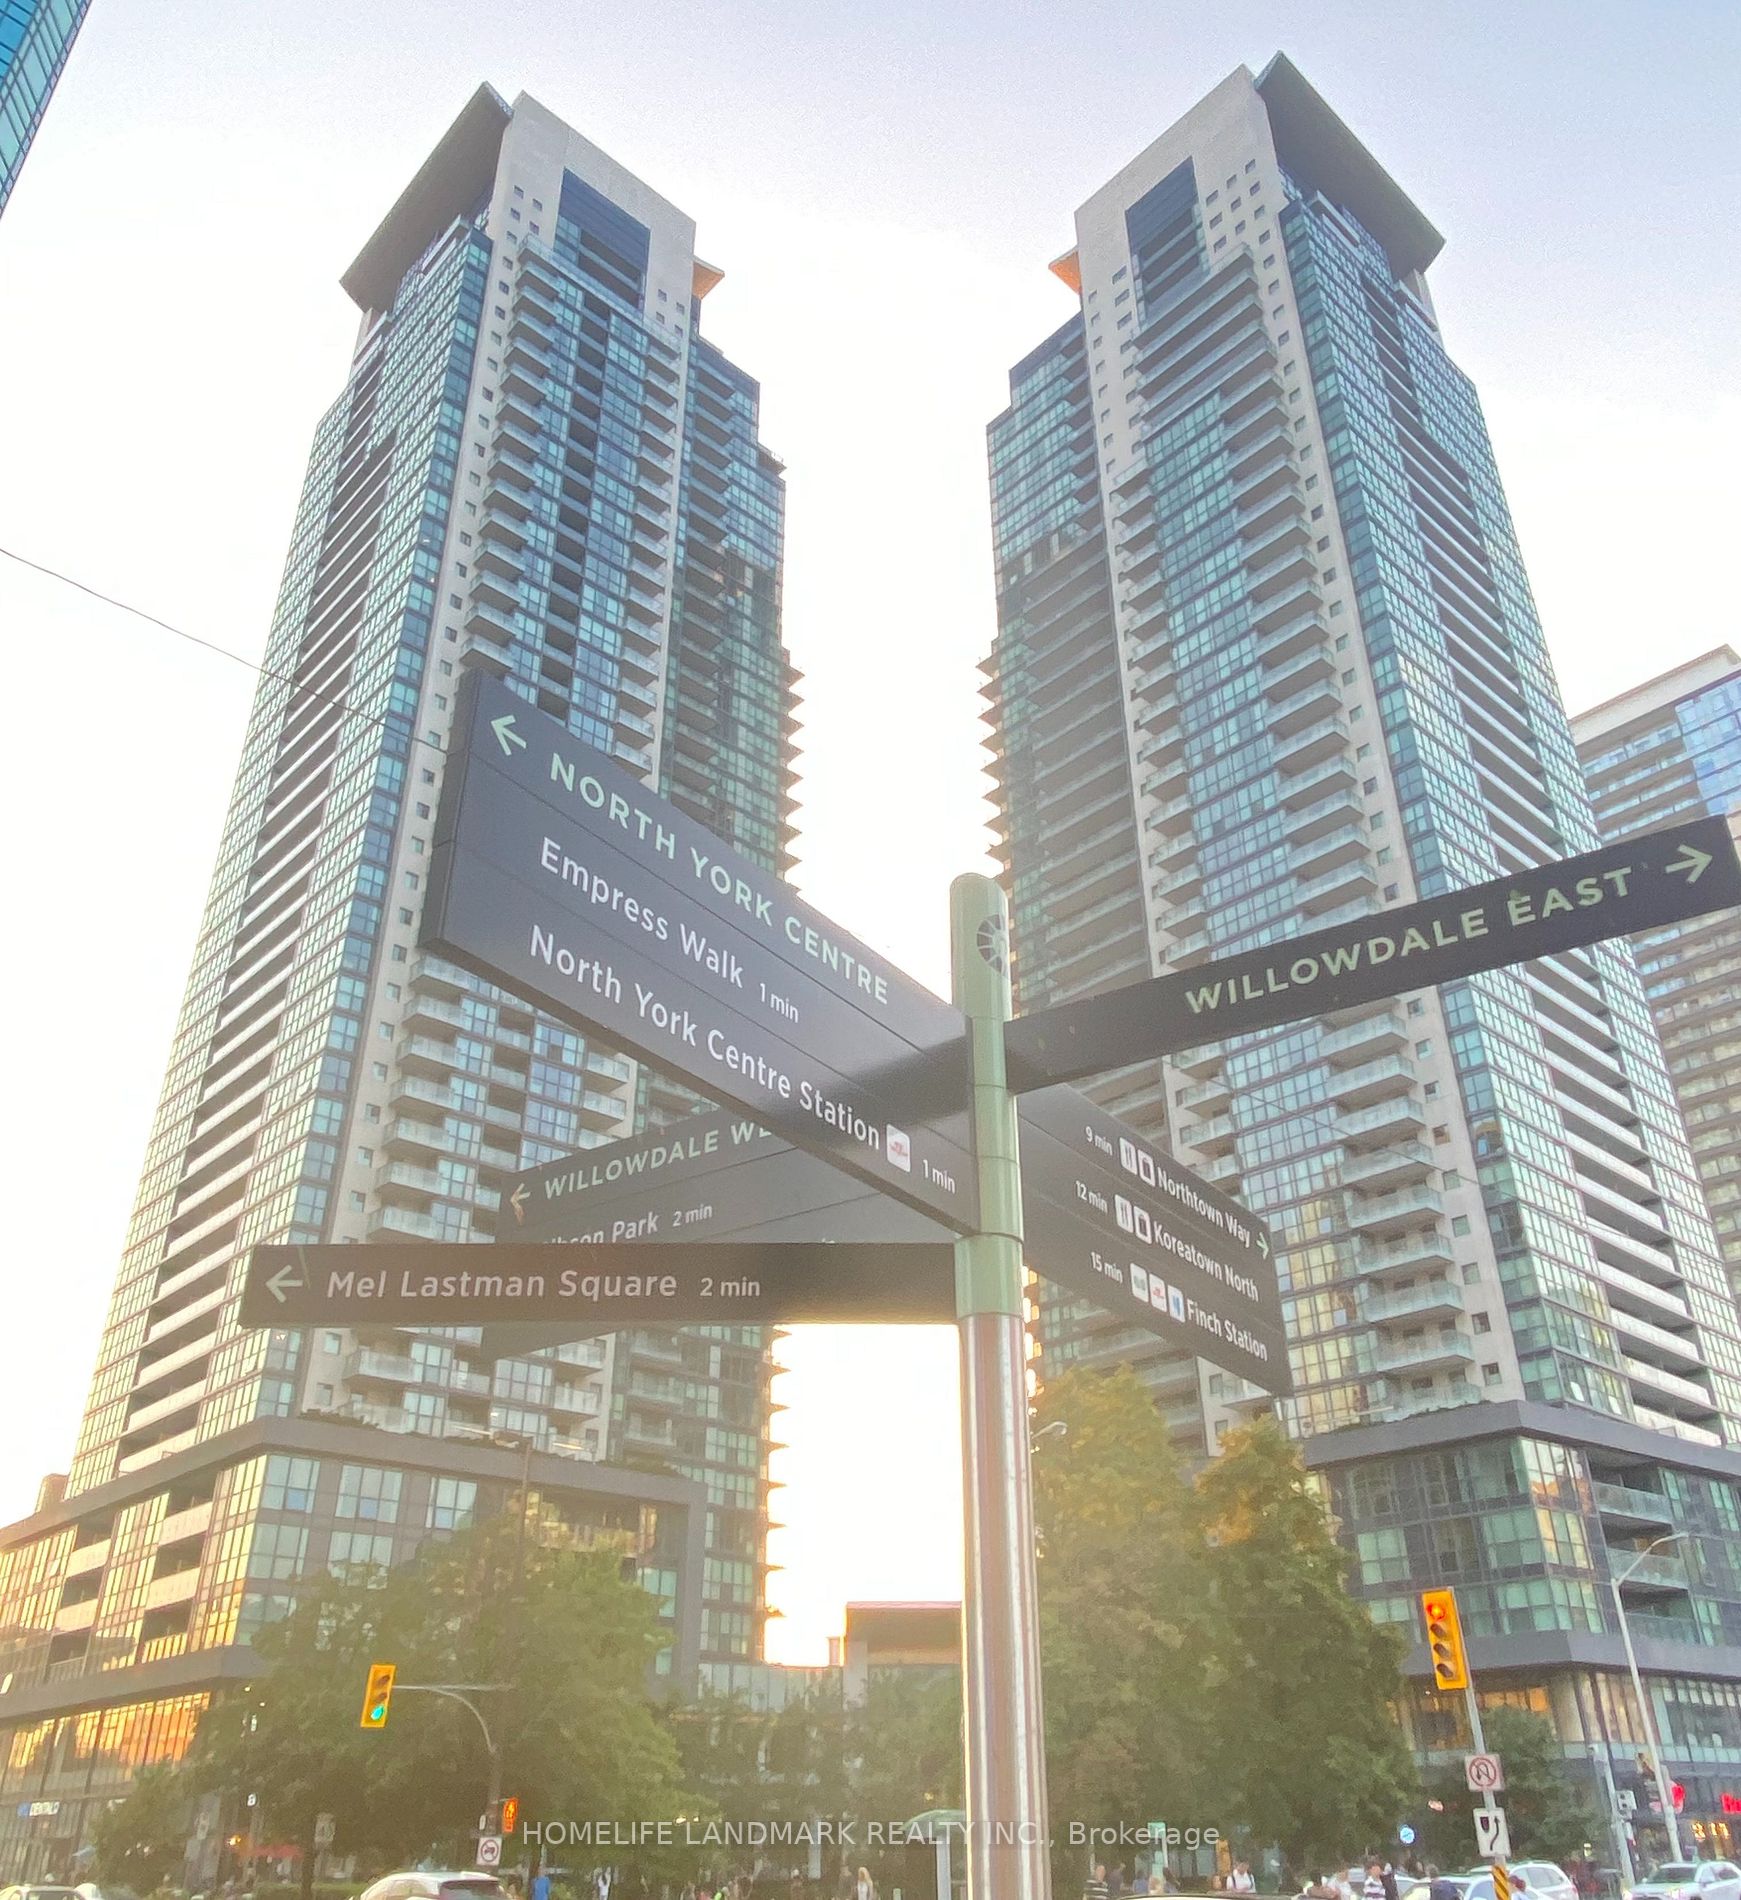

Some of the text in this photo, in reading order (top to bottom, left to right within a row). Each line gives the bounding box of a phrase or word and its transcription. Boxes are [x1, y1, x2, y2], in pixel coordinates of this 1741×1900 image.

[541, 837, 669, 941] Empress
[680, 922, 744, 989] Walk
[550, 752, 889, 1005] NORTH YORK CENTRE
[1185, 866, 1634, 1014] WILLOWDALE EAST
[530, 924, 622, 1005] North
[635, 983, 697, 1047] York
[707, 1029, 791, 1098] Centre
[800, 1080, 880, 1150] Station
[544, 1130, 719, 1199] WILLOWDALE
[612, 1211, 659, 1242] Park
[672, 1213, 683, 1227] 2
[685, 1202, 713, 1224] min
[1085, 1126, 1250, 1249] 9 min Northtown Way
[327, 1270, 761, 1301] Mel Lastman Square 2 min
[1076, 1180, 1259, 1302] 12 min Koreatown North
[1091, 1252, 1268, 1362] 15 min Finch Station
